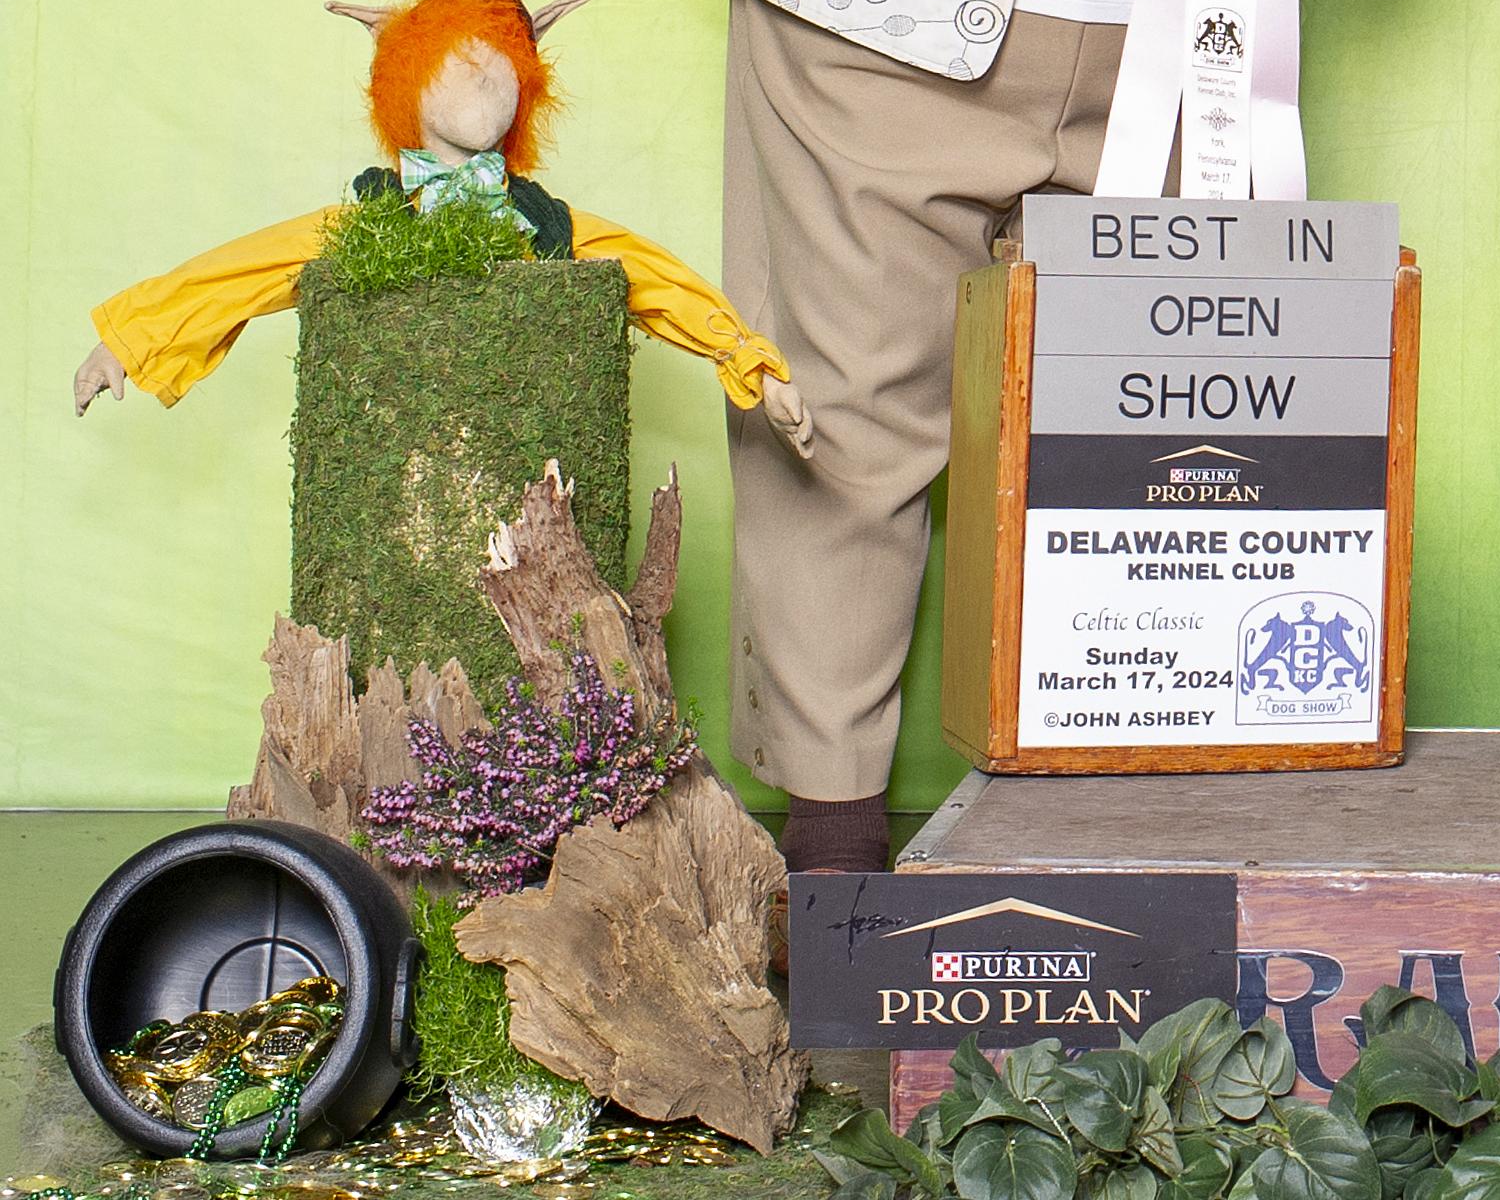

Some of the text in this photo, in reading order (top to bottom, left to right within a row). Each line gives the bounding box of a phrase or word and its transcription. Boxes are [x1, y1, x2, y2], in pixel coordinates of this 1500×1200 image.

[1091, 213, 1334, 263] BEST IN
[1149, 294, 1281, 337] OPEN
[1118, 372, 1296, 420] SHOW
[1184, 471, 1236, 481] PURINA
[1145, 485, 1261, 502] PRO PLAN
[1046, 529, 1374, 555] DELAWARE COUNTY
[1127, 562, 1296, 581] KENNEL CLUB
[1071, 606, 1205, 631] Celtic Classic
[1294, 624, 1321, 646] D
[1085, 647, 1179, 669] Sunday
[1294, 647, 1319, 669] C
[1038, 670, 1234, 694] March 17, 2024
[1293, 670, 1318, 683] KC
[1127, 710, 1216, 727] ASHBEY
[1271, 702, 1338, 714] DOG SHOW
[964, 956, 1084, 978] PURINA
[876, 988, 1145, 1025] PRO PLAN
